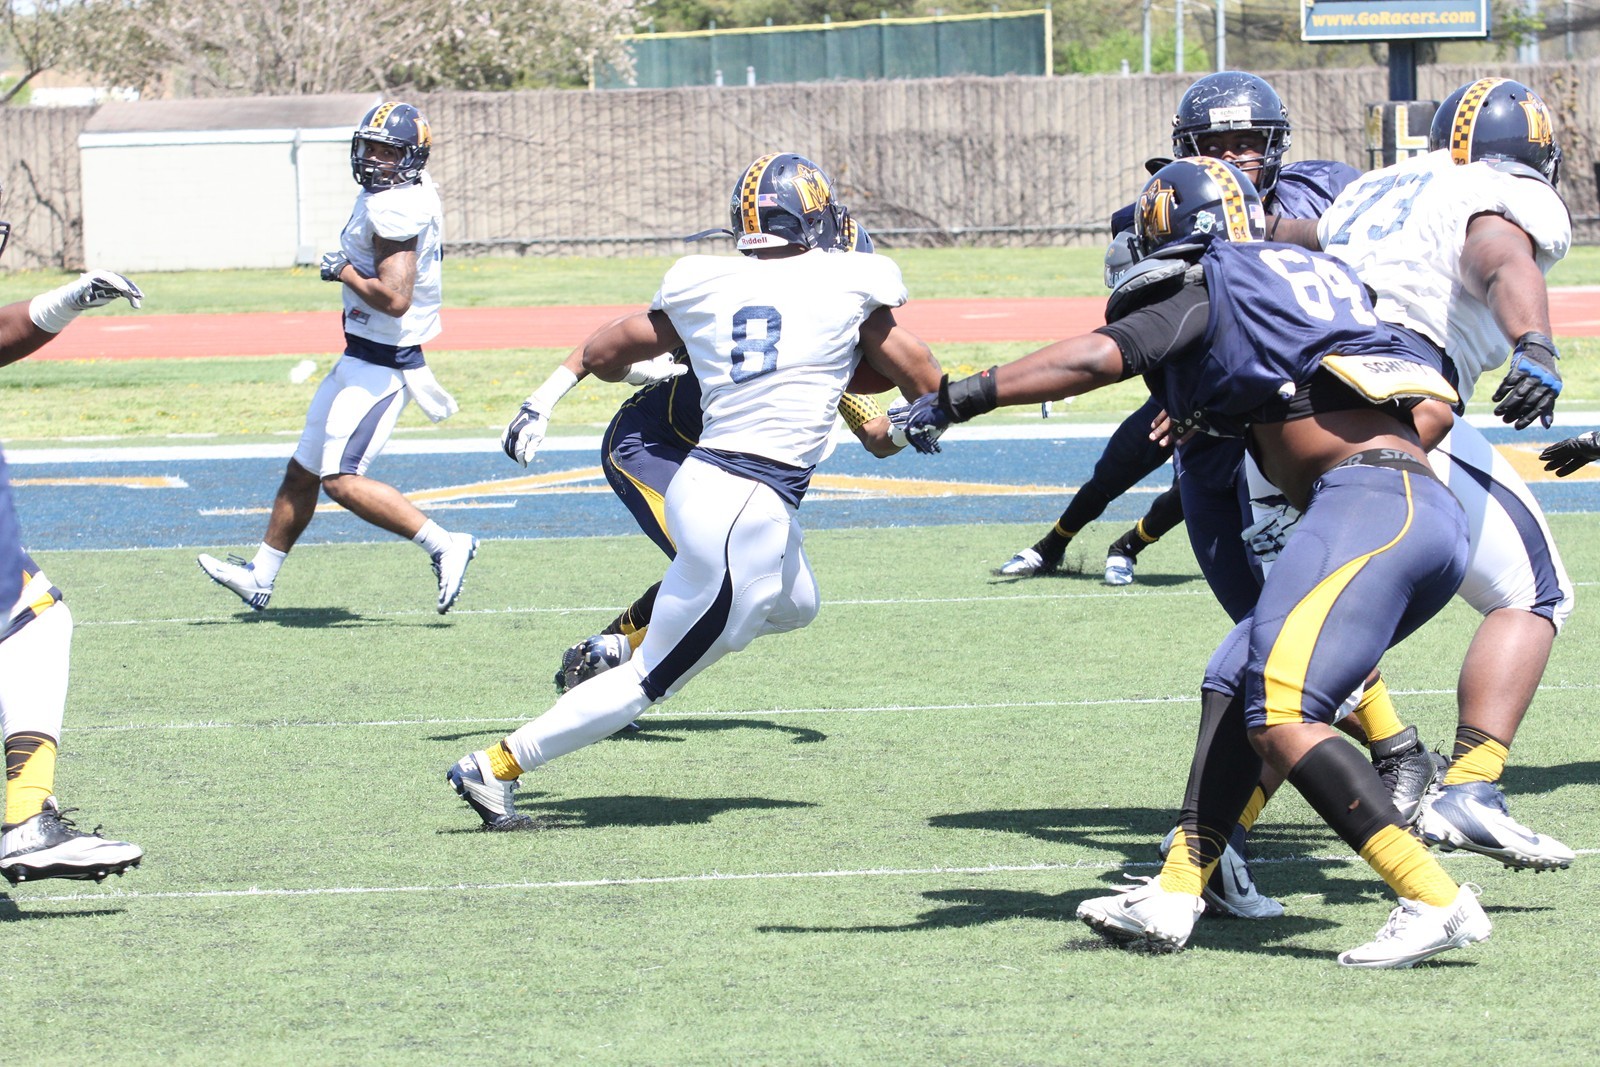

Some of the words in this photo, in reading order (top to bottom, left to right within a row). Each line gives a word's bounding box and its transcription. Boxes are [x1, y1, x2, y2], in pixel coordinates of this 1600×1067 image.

[1311, 11, 1477, 27] www.GoRacers.com
[748, 220, 756, 231] 6
[1233, 226, 1247, 239] 64
[741, 237, 768, 245] Riddell
[1259, 249, 1377, 326] 64
[730, 306, 782, 384] 8
[1443, 905, 1469, 938] NIKE
